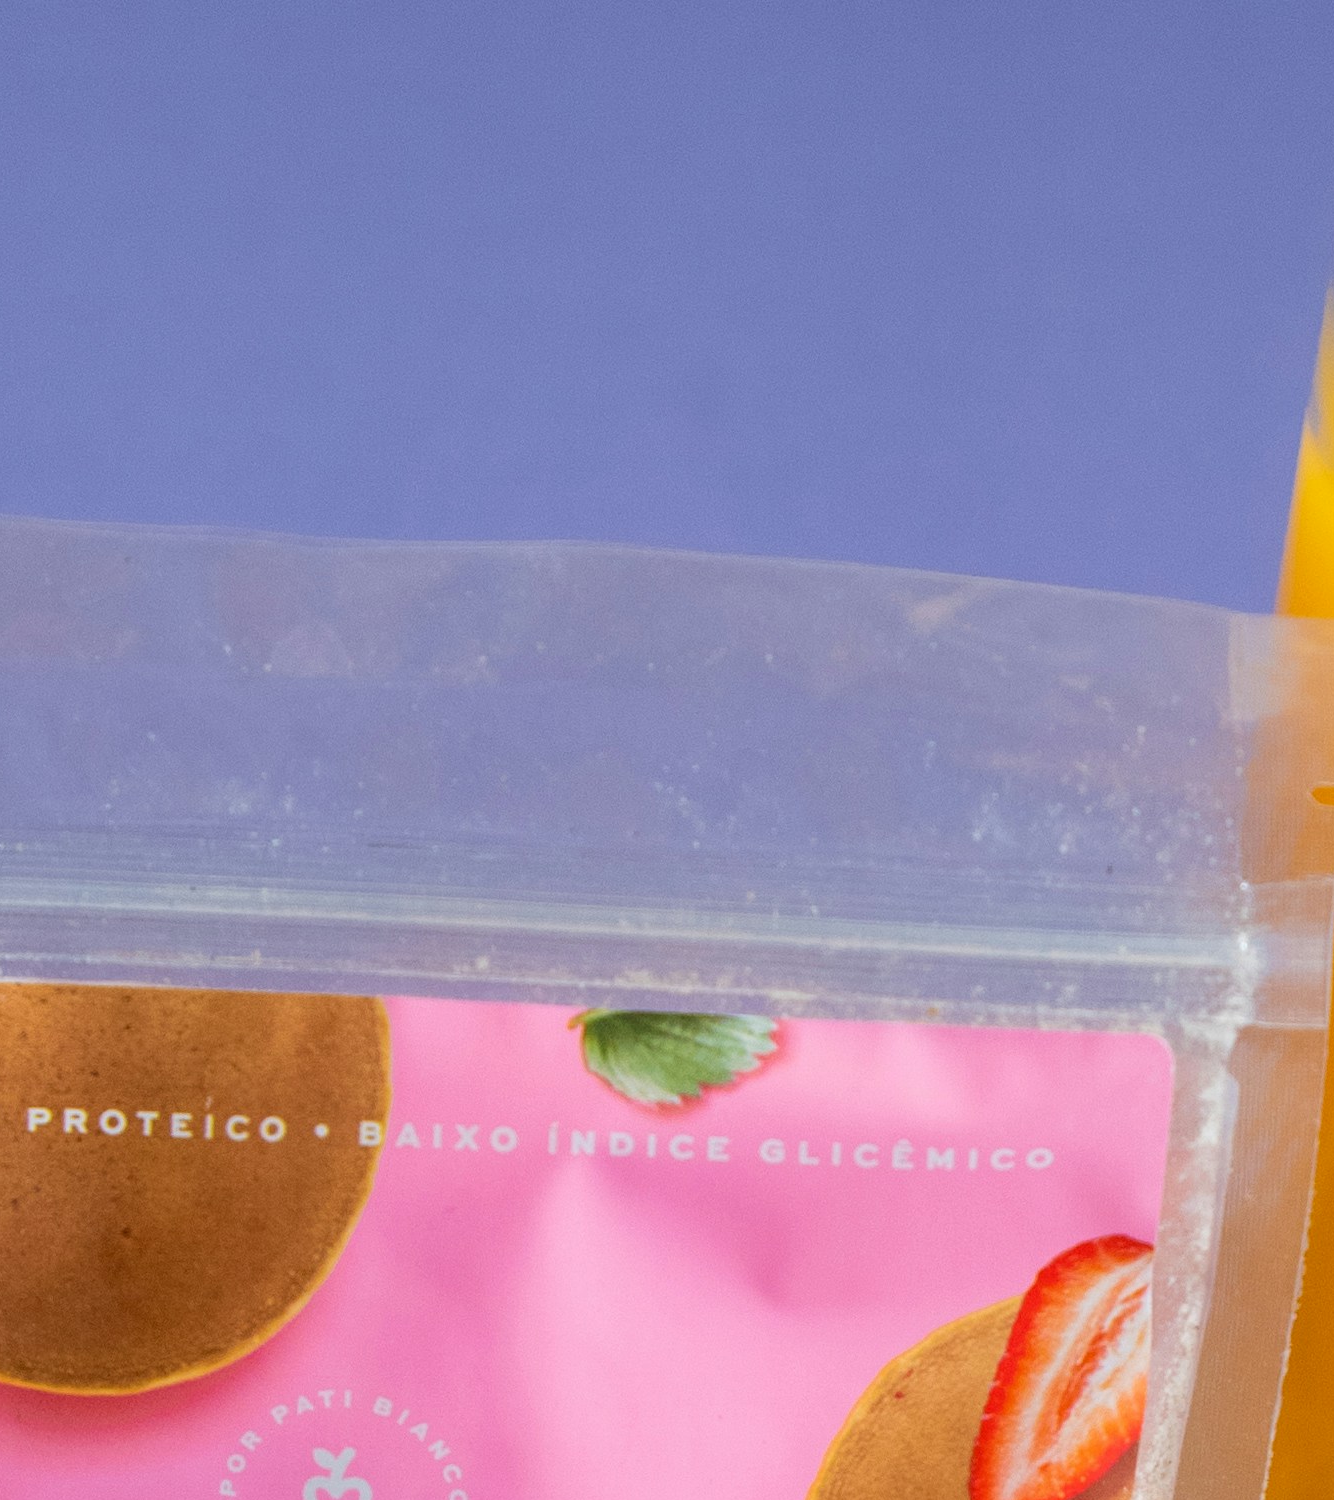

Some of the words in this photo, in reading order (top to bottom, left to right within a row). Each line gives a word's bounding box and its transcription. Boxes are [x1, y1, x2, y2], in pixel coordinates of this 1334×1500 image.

[358, 1119, 519, 1153] BAIXO
[548, 1120, 730, 1162] ÍNDICE
[759, 1138, 1055, 1171] GLICÊMICO
[219, 1430, 263, 1497] POR
[270, 1388, 353, 1425] PATI
